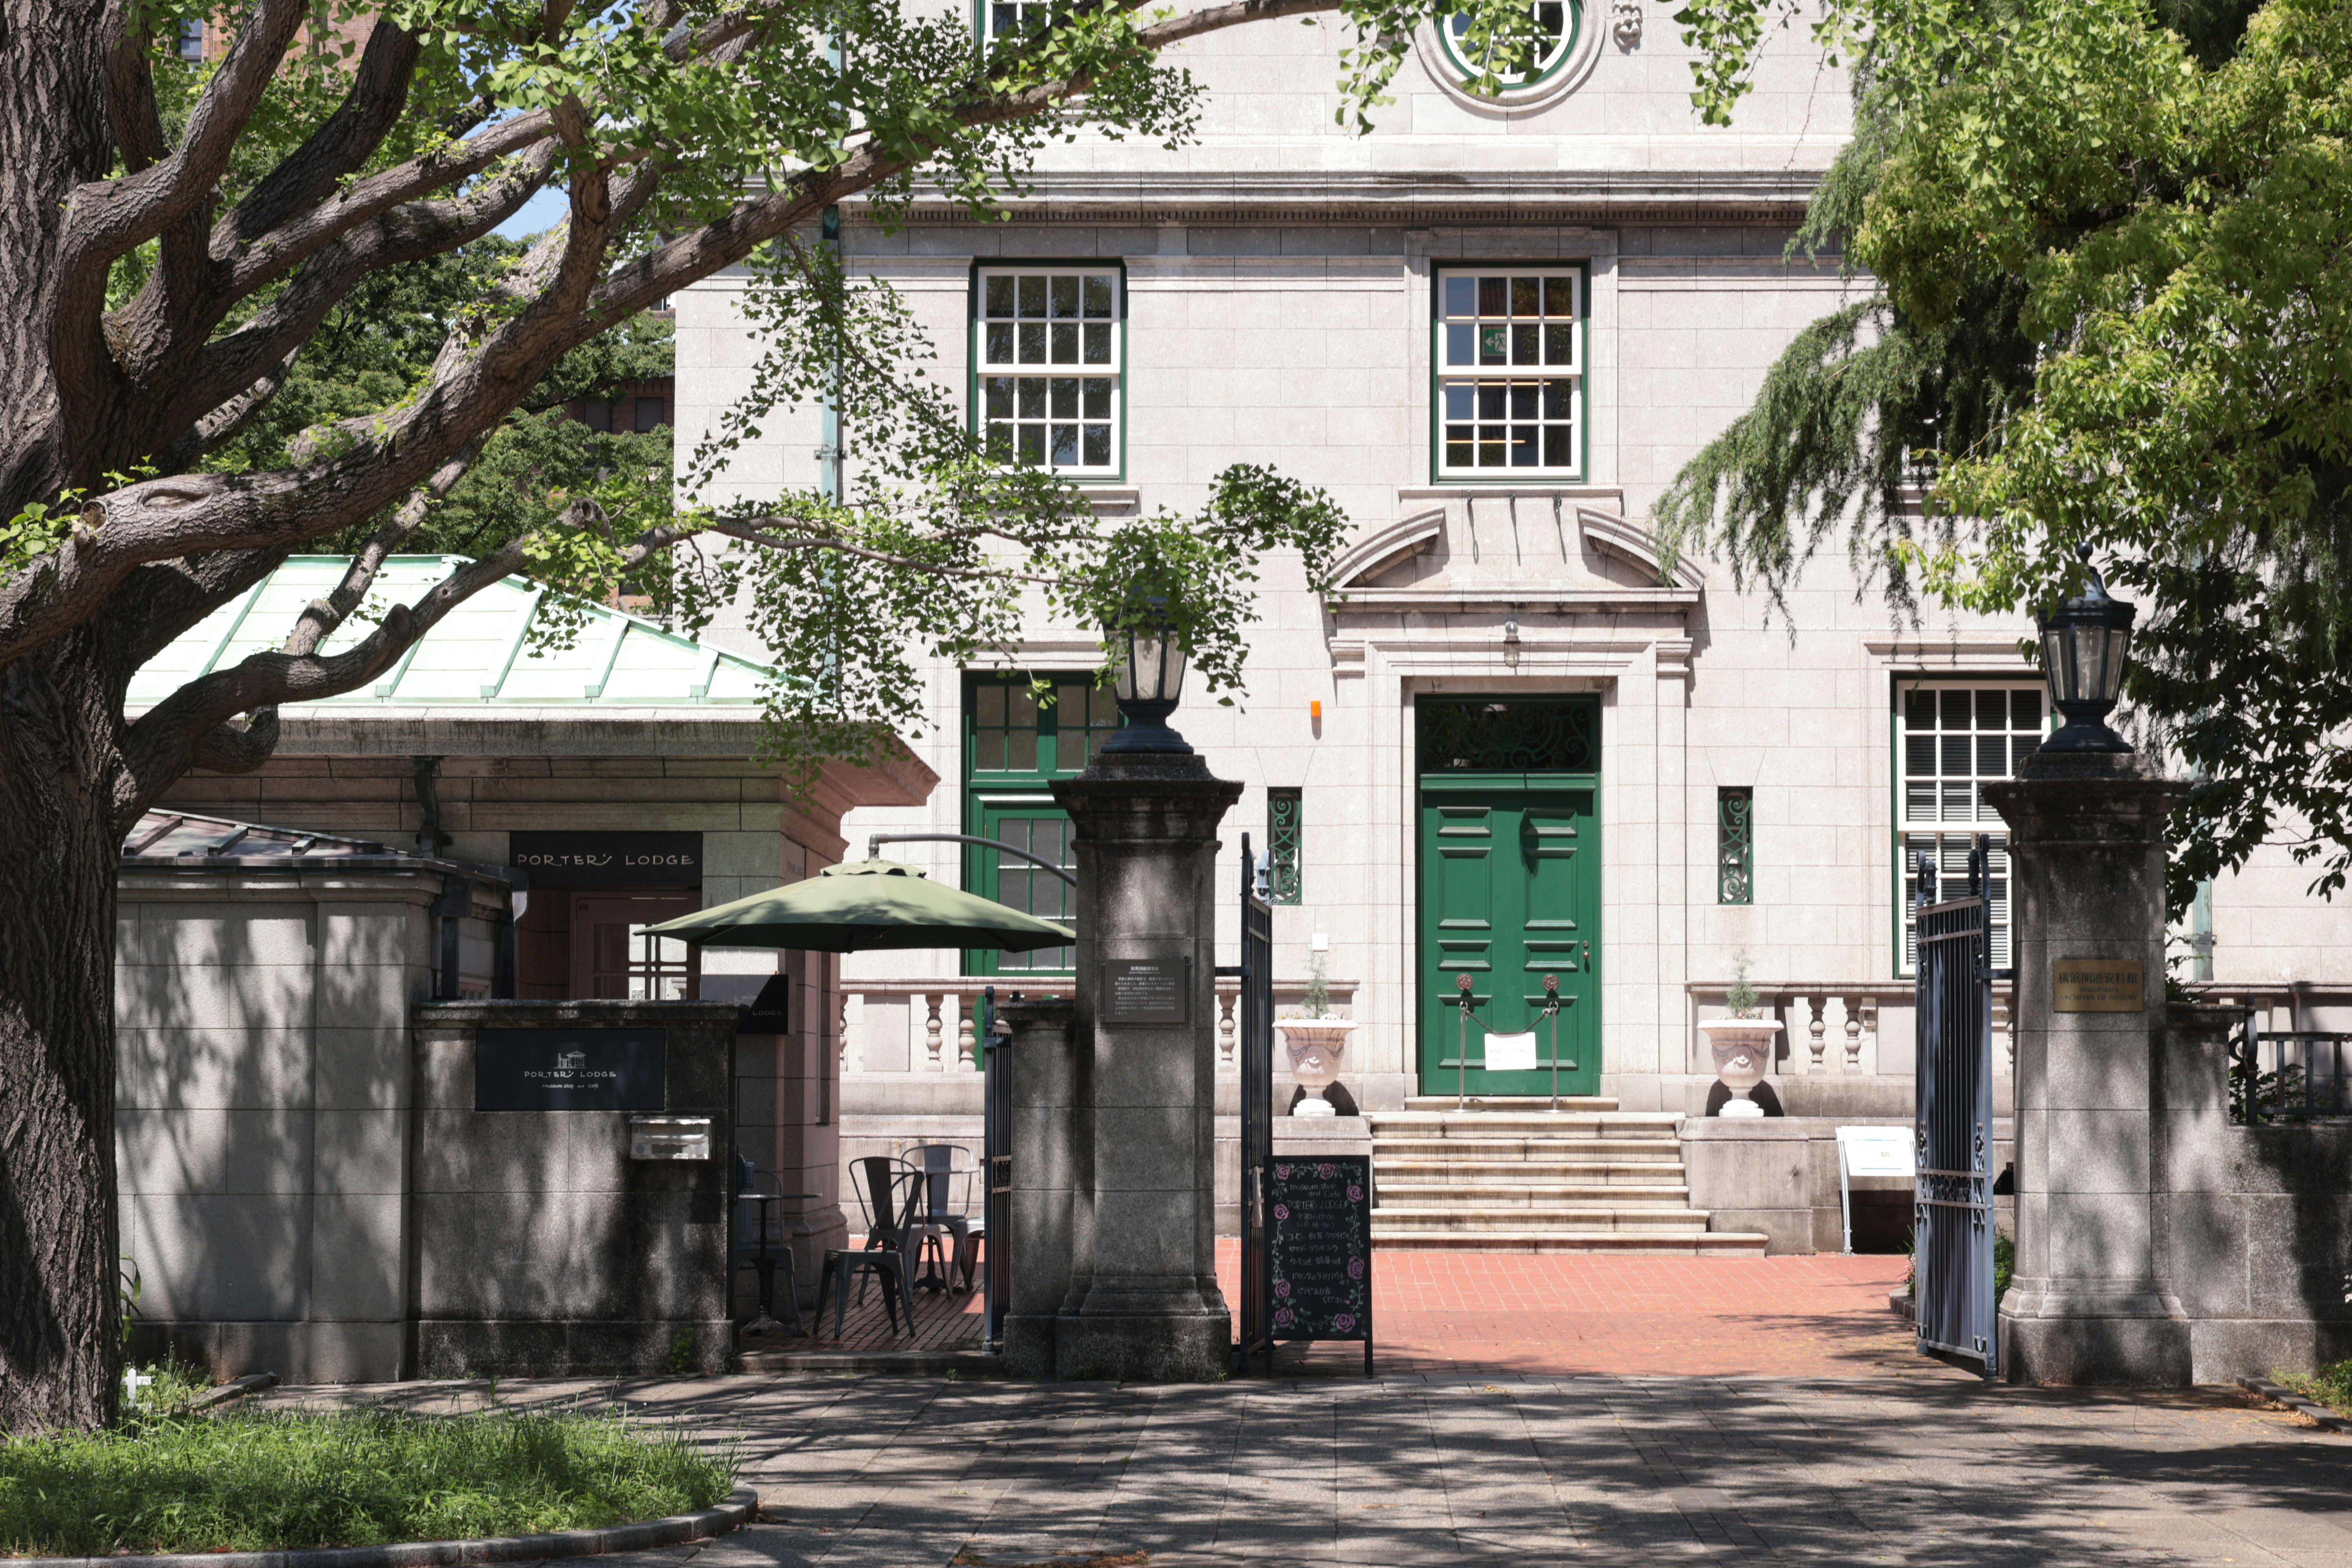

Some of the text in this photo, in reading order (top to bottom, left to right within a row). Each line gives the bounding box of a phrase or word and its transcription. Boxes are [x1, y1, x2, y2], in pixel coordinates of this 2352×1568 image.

[626, 855, 694, 865] LODGE
[2059, 972, 2138, 984] 横浜開港資料館
[1319, 1200, 1344, 1209] LODGE
[1308, 1232, 1323, 1240] 紅茶
